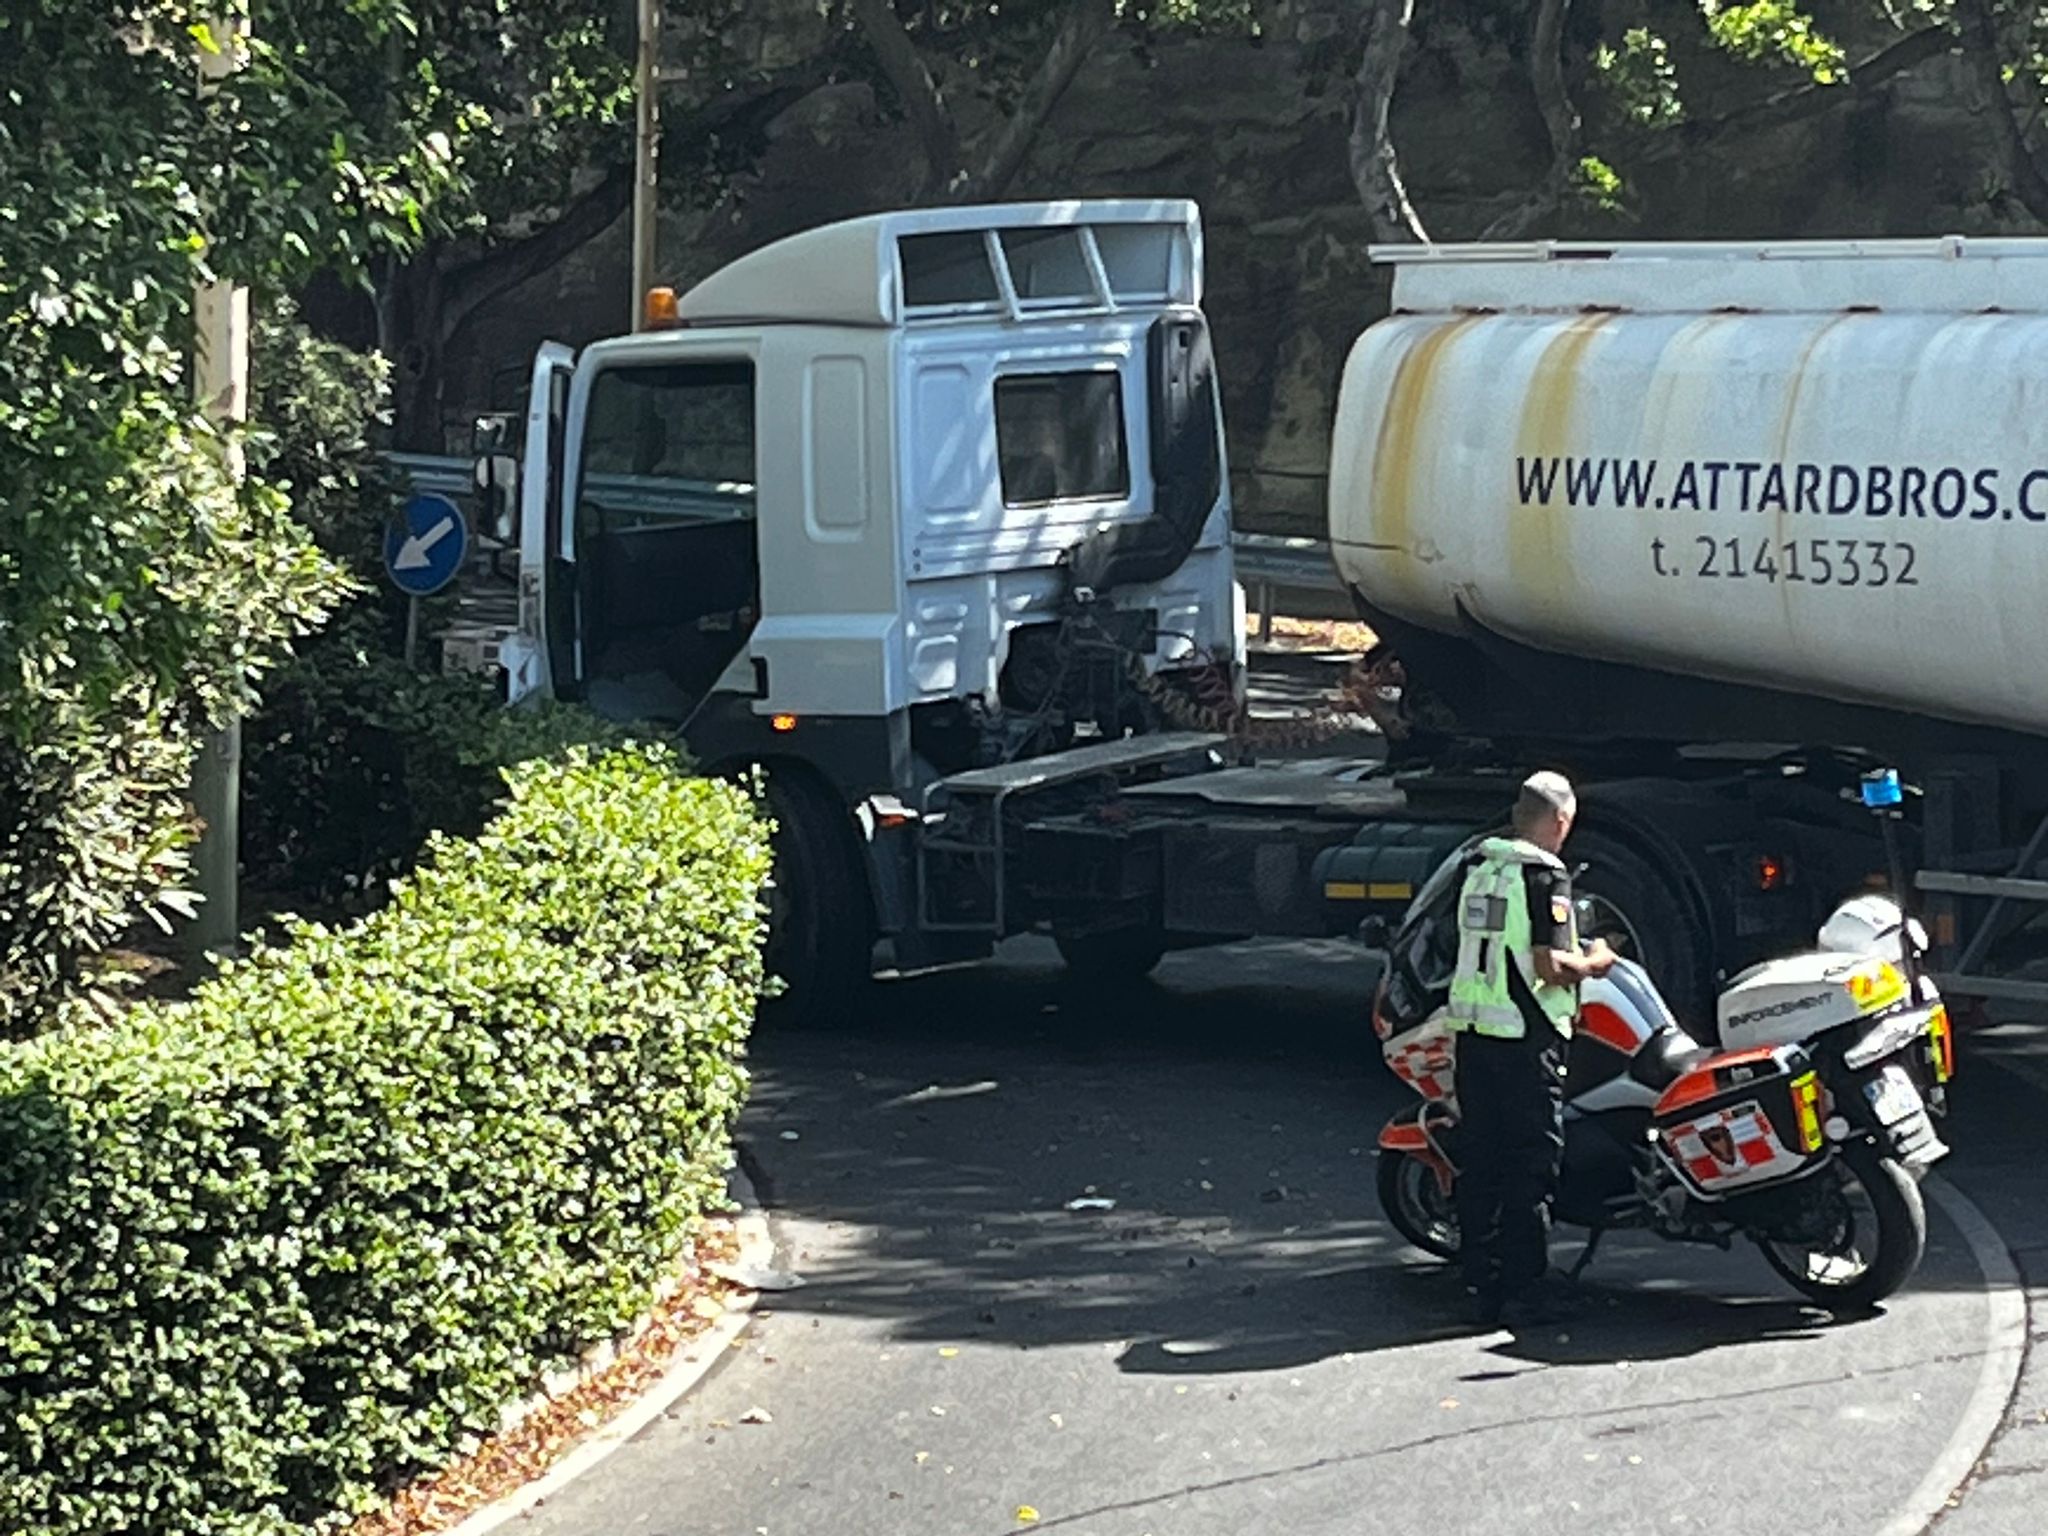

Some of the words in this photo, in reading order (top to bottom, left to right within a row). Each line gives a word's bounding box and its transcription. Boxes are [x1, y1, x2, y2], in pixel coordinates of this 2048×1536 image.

[1516, 456, 2048, 522] WWW.ATTARDBROS.C
[1651, 536, 1681, 577] t.
[1696, 536, 1919, 587] 21415332
